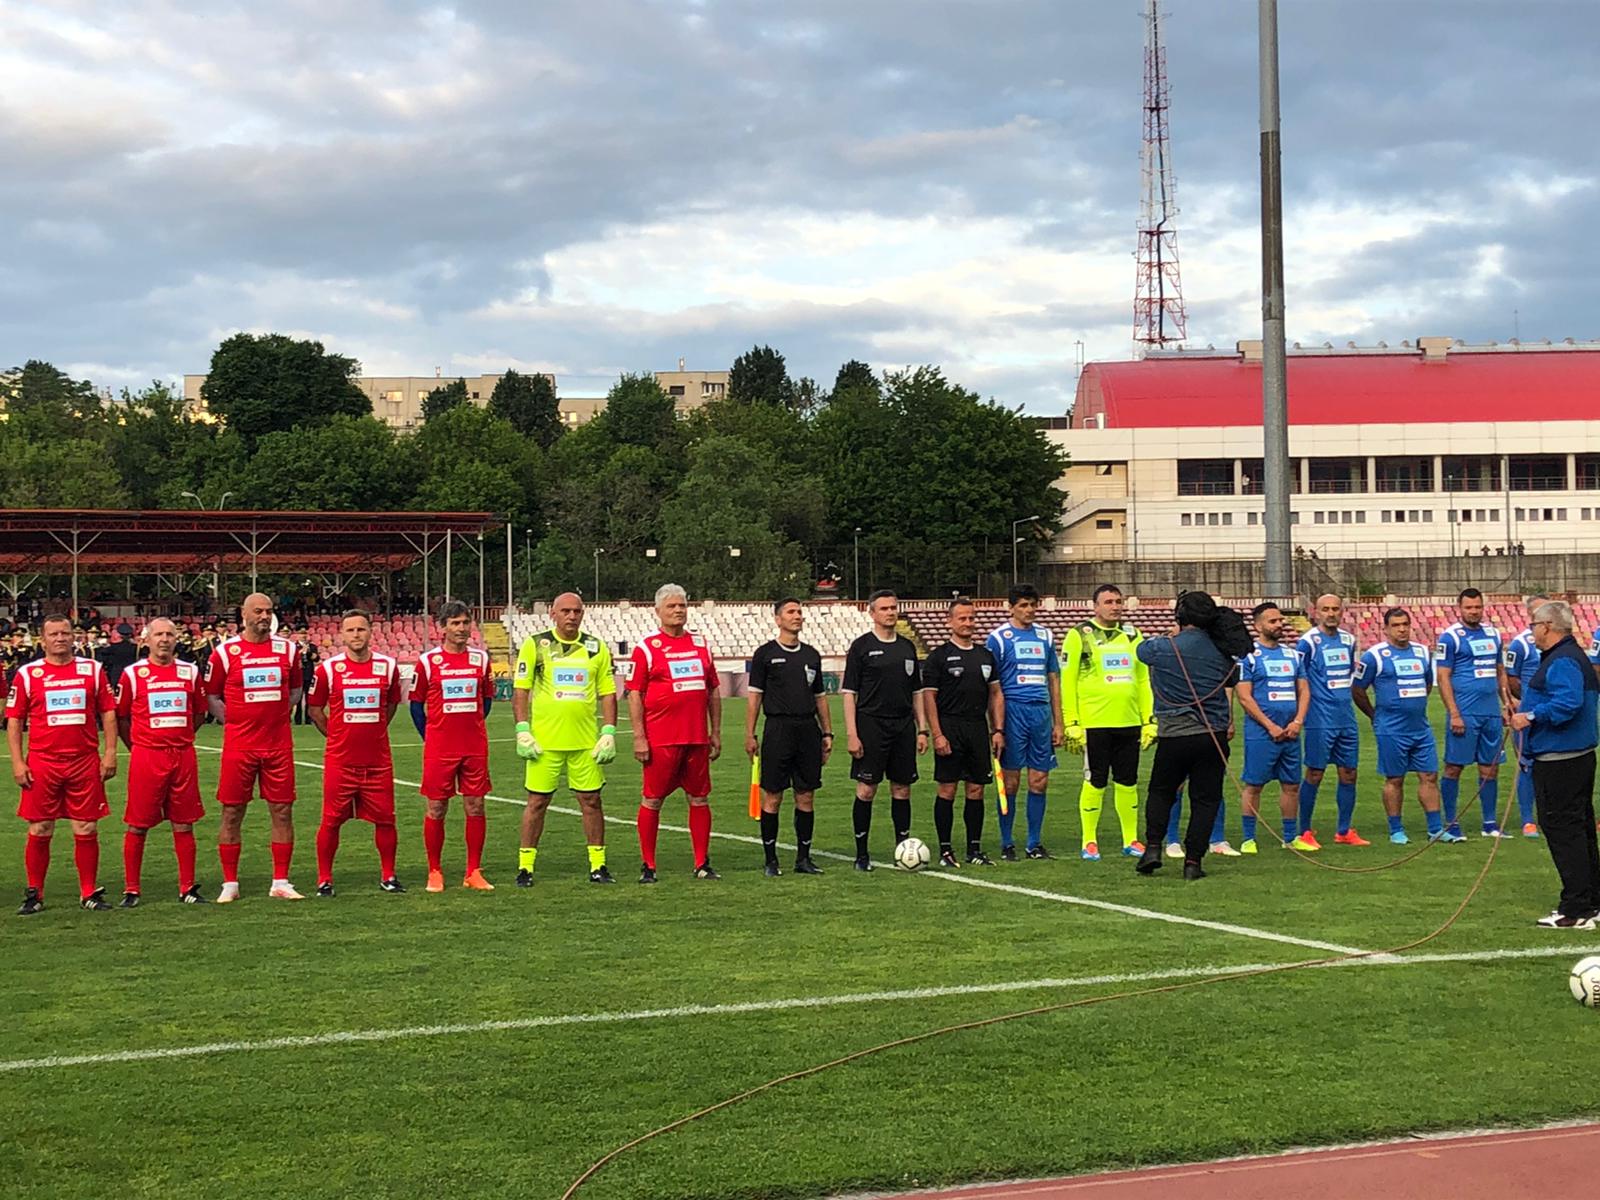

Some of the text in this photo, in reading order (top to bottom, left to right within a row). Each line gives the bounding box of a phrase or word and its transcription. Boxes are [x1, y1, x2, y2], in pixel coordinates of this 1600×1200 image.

[674, 666, 690, 674] BCR
[248, 675, 266, 683] BCR
[558, 674, 574, 682] BCR
[447, 686, 464, 694] BCR
[51, 697, 70, 706] BCR
[154, 699, 173, 708] BCR
[348, 696, 365, 704] BCR
